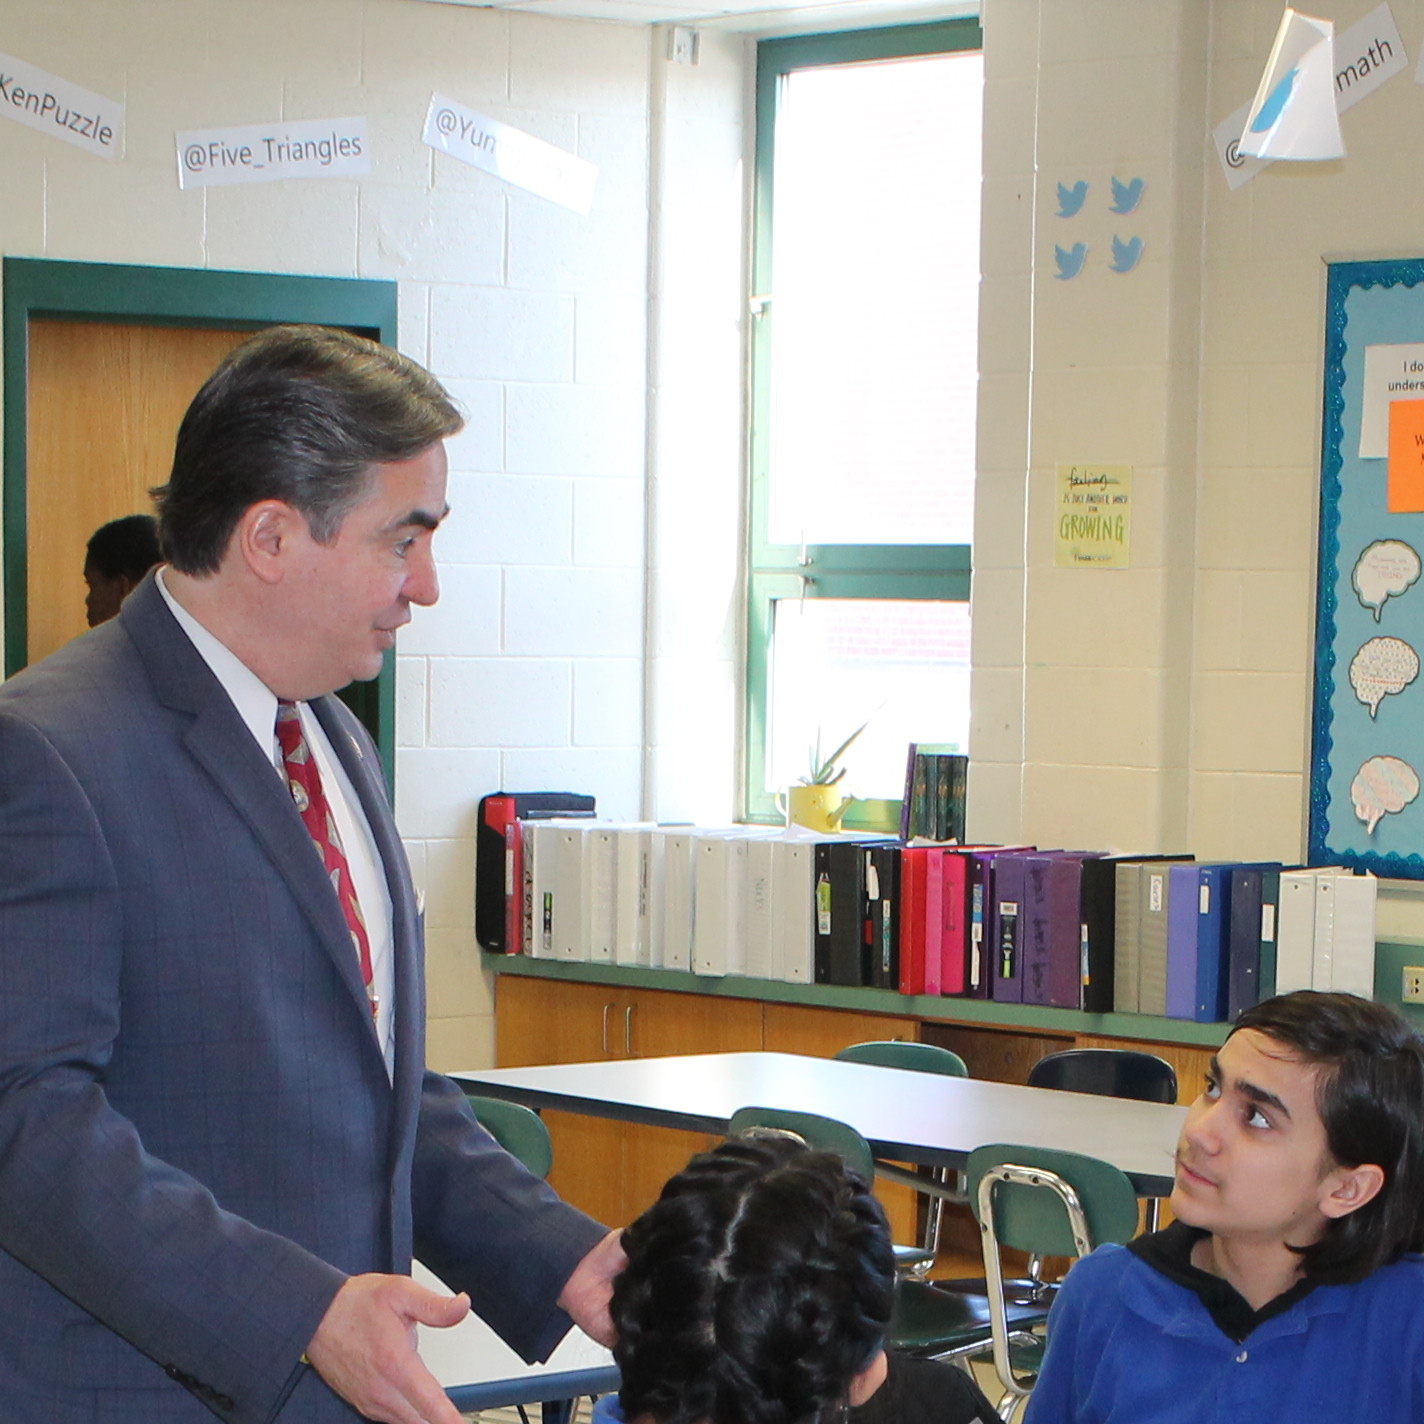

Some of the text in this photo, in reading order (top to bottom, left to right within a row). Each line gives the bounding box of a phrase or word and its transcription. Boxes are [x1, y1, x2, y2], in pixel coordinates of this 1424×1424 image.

[184, 132, 362, 173] @Five_Triangles
[1403, 361, 1407, 373] I
[1060, 514, 1124, 544] GROWING
